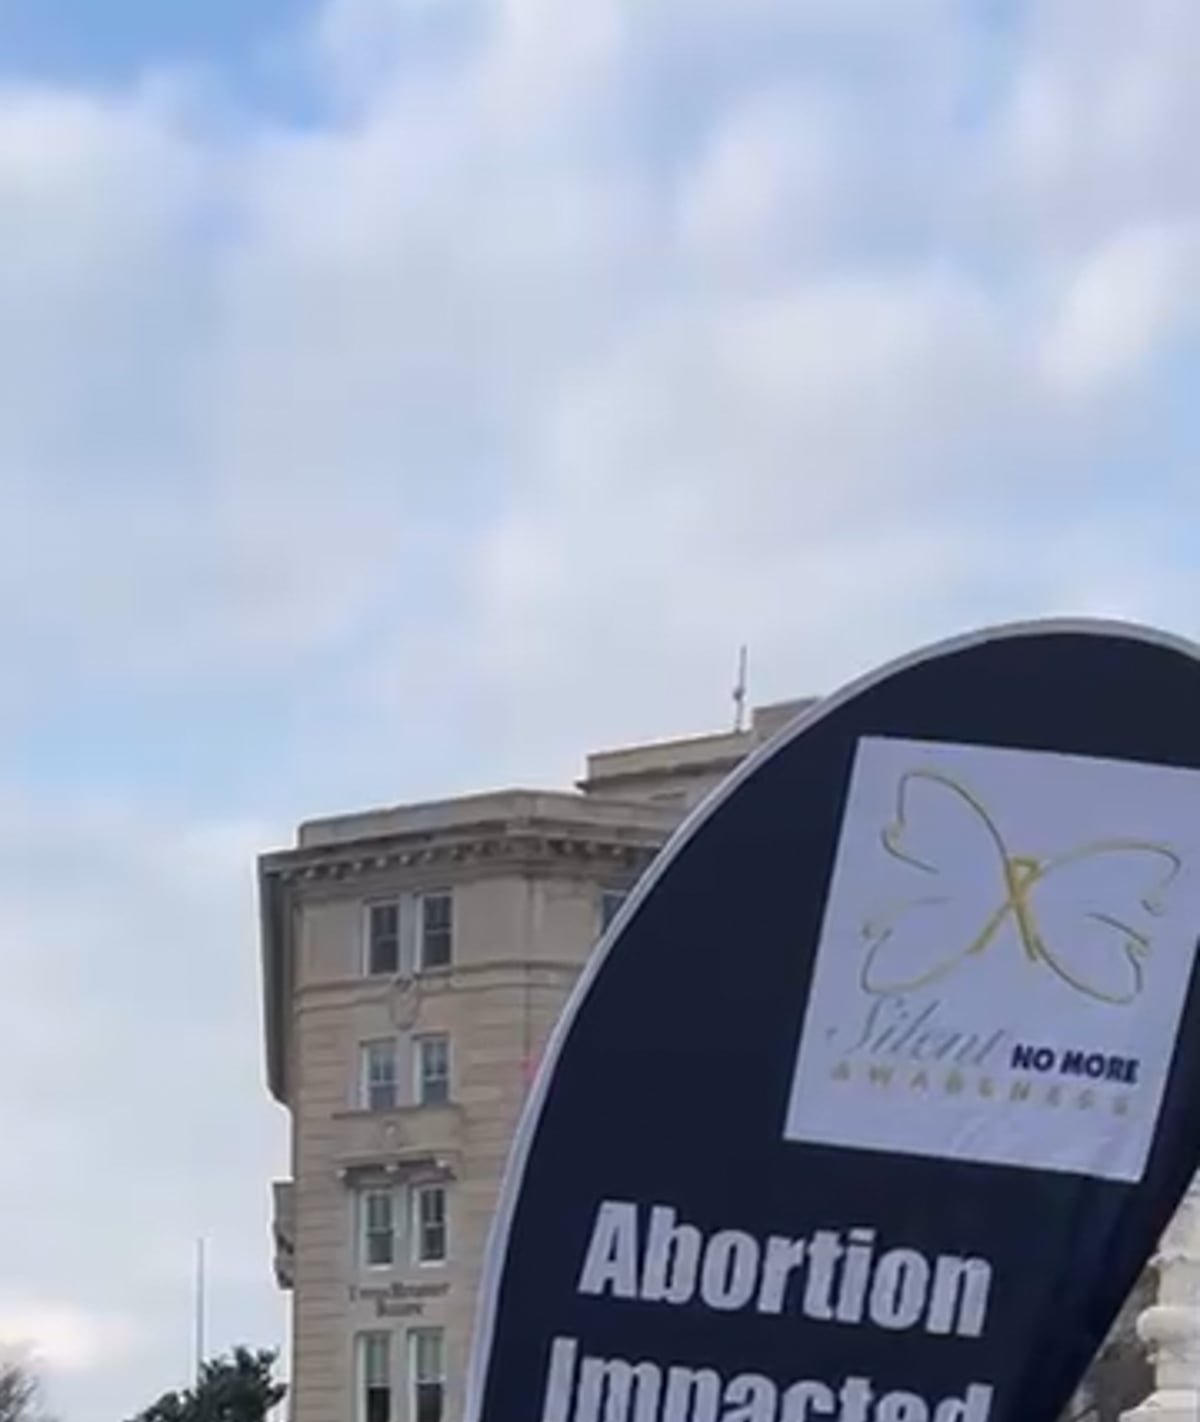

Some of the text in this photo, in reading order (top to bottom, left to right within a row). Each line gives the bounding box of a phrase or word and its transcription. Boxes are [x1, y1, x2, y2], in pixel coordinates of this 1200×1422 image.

[826, 995, 1140, 1085] Silent NO MORE
[578, 1200, 992, 1337] Abortion
